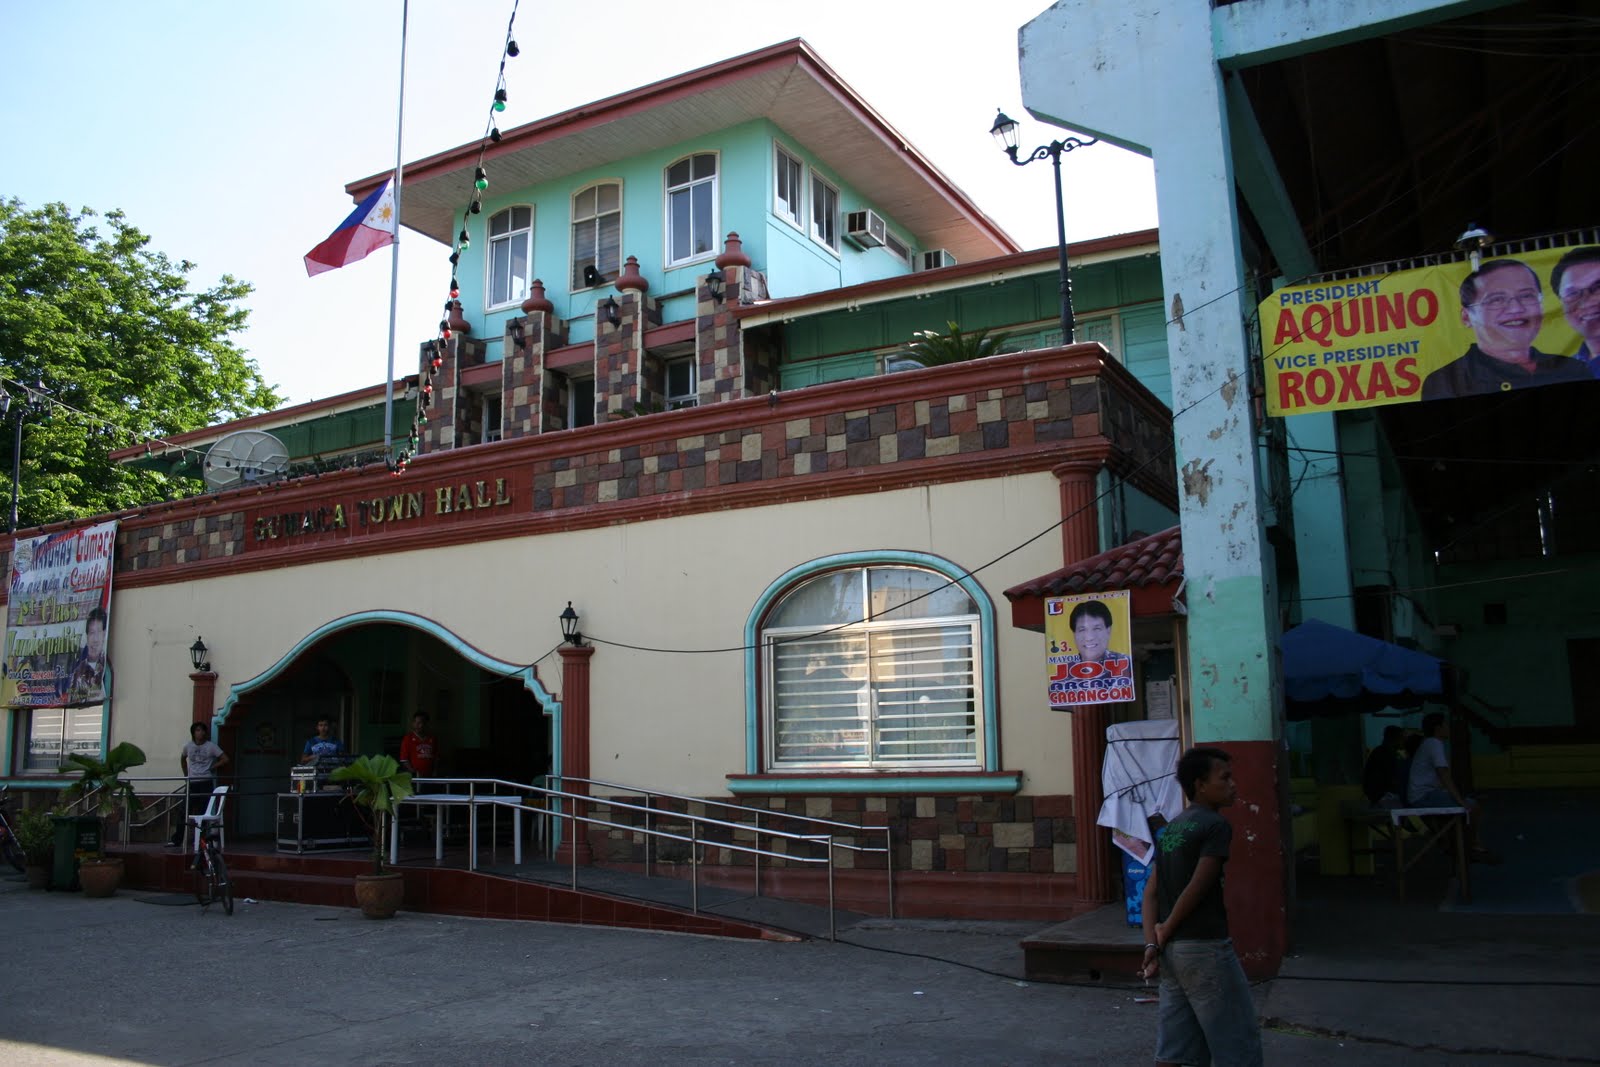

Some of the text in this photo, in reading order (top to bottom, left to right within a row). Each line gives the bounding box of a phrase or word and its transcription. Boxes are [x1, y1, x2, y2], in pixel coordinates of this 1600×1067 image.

[1280, 280, 1380, 307] PRESIDENT
[1273, 288, 1439, 348] AQUINO
[1273, 341, 1420, 370] VICE PRESIDENT
[1278, 358, 1421, 409] ROXAS
[358, 491, 425, 527] TOWN
[434, 478, 511, 514] HALL
[1048, 655, 1080, 664] MAYOR
[1050, 659, 1129, 681] JOY
[1049, 687, 1132, 703] CABANGON
[1050, 678, 1131, 691] ARCAYA
